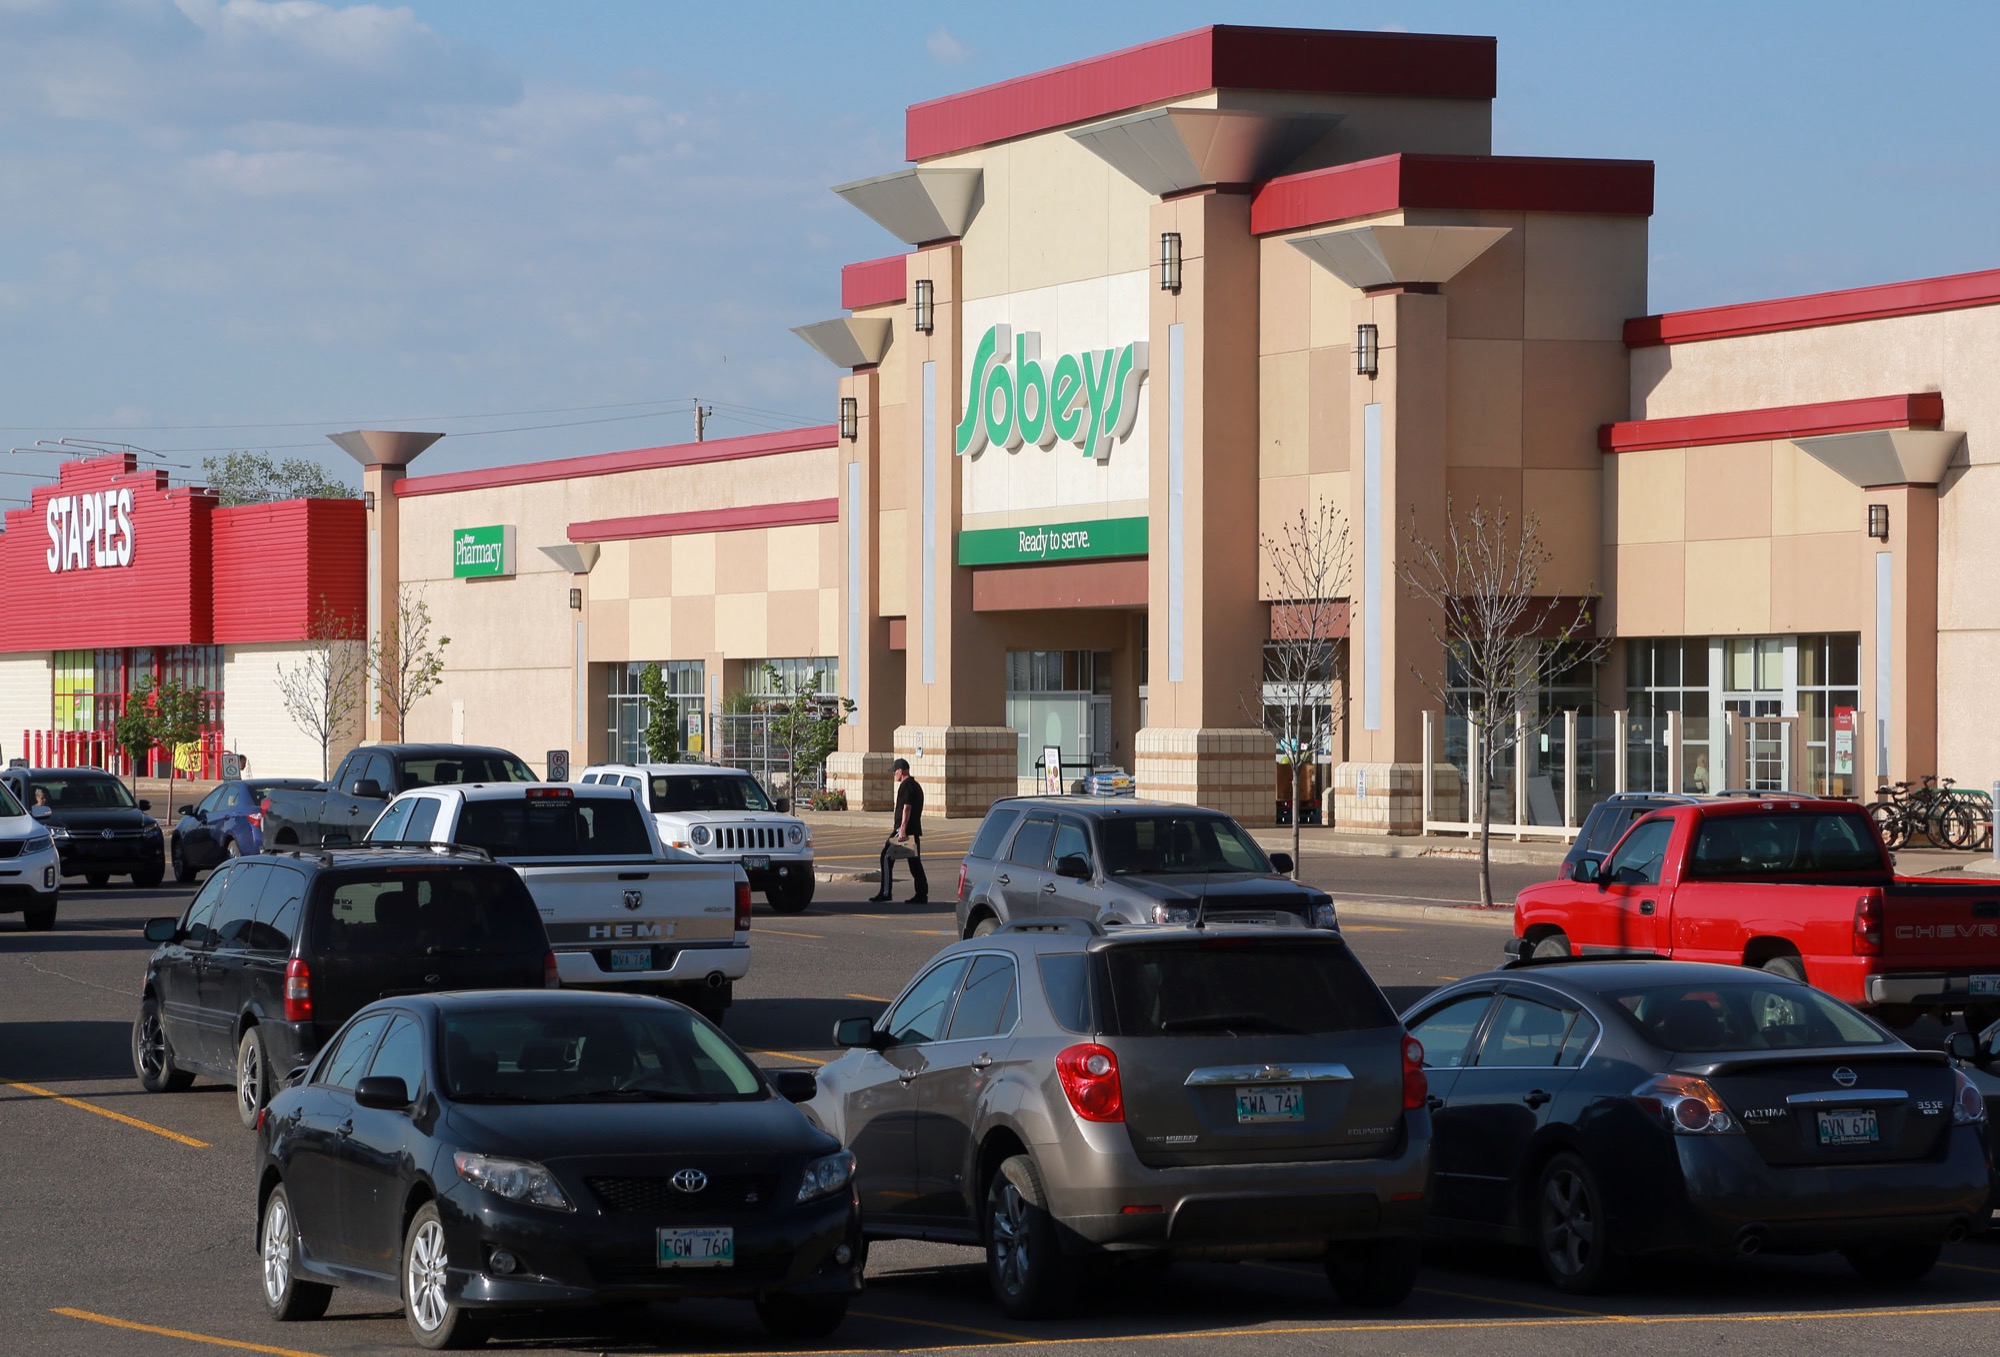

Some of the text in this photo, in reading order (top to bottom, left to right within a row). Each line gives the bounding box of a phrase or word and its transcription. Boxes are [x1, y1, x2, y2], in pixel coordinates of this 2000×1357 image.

[956, 324, 1142, 458] Sobeys
[46, 488, 133, 573] STAPLES
[1018, 527, 1090, 558] Ready to serve.
[455, 538, 502, 571] Pharmacy
[588, 924, 676, 939] HEMI
[633, 954, 650, 966] 784
[1971, 980, 1987, 992] HEM
[1240, 1093, 1299, 1113] FWA 741
[1744, 1108, 1787, 1118] ALTIMA
[1347, 1127, 1384, 1136] EQUINOX
[1820, 1117, 1877, 1136] GVN 670
[1840, 1134, 1870, 1142] Birchwood
[664, 1237, 731, 1257] FGW 760
